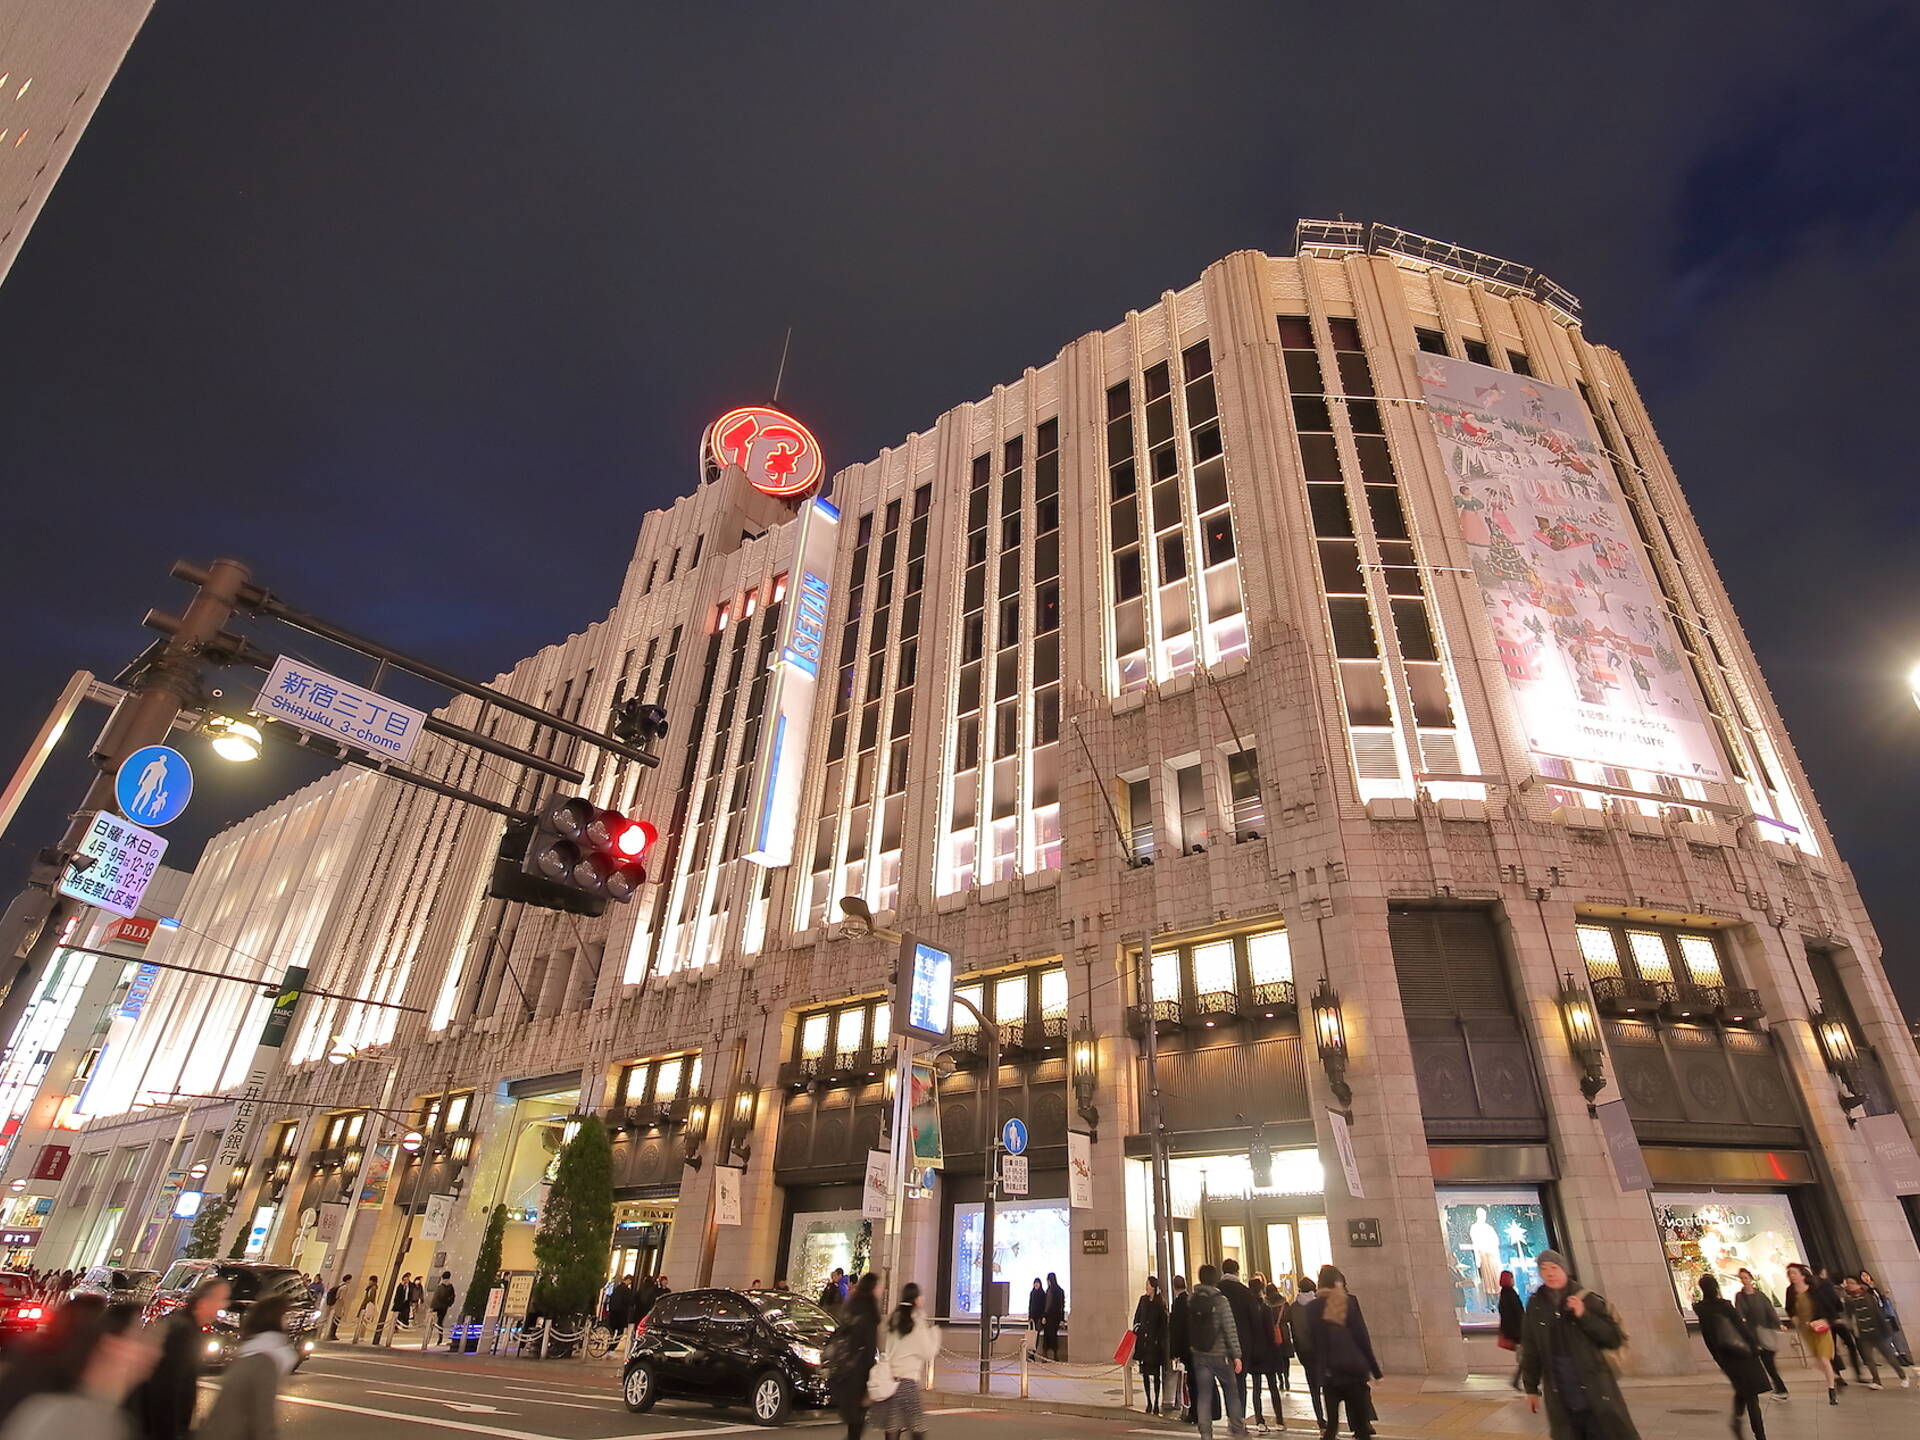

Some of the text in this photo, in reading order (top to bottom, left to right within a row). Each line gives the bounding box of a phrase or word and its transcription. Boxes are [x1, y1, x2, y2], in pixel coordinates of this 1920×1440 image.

[784, 571, 829, 676] ISETAN
[271, 695, 401, 751] Shinjuku 3-chome
[280, 671, 410, 736] 新宿三丁目
[122, 923, 151, 940] BLD.
[219, 1070, 267, 1166] 三井住友銀行
